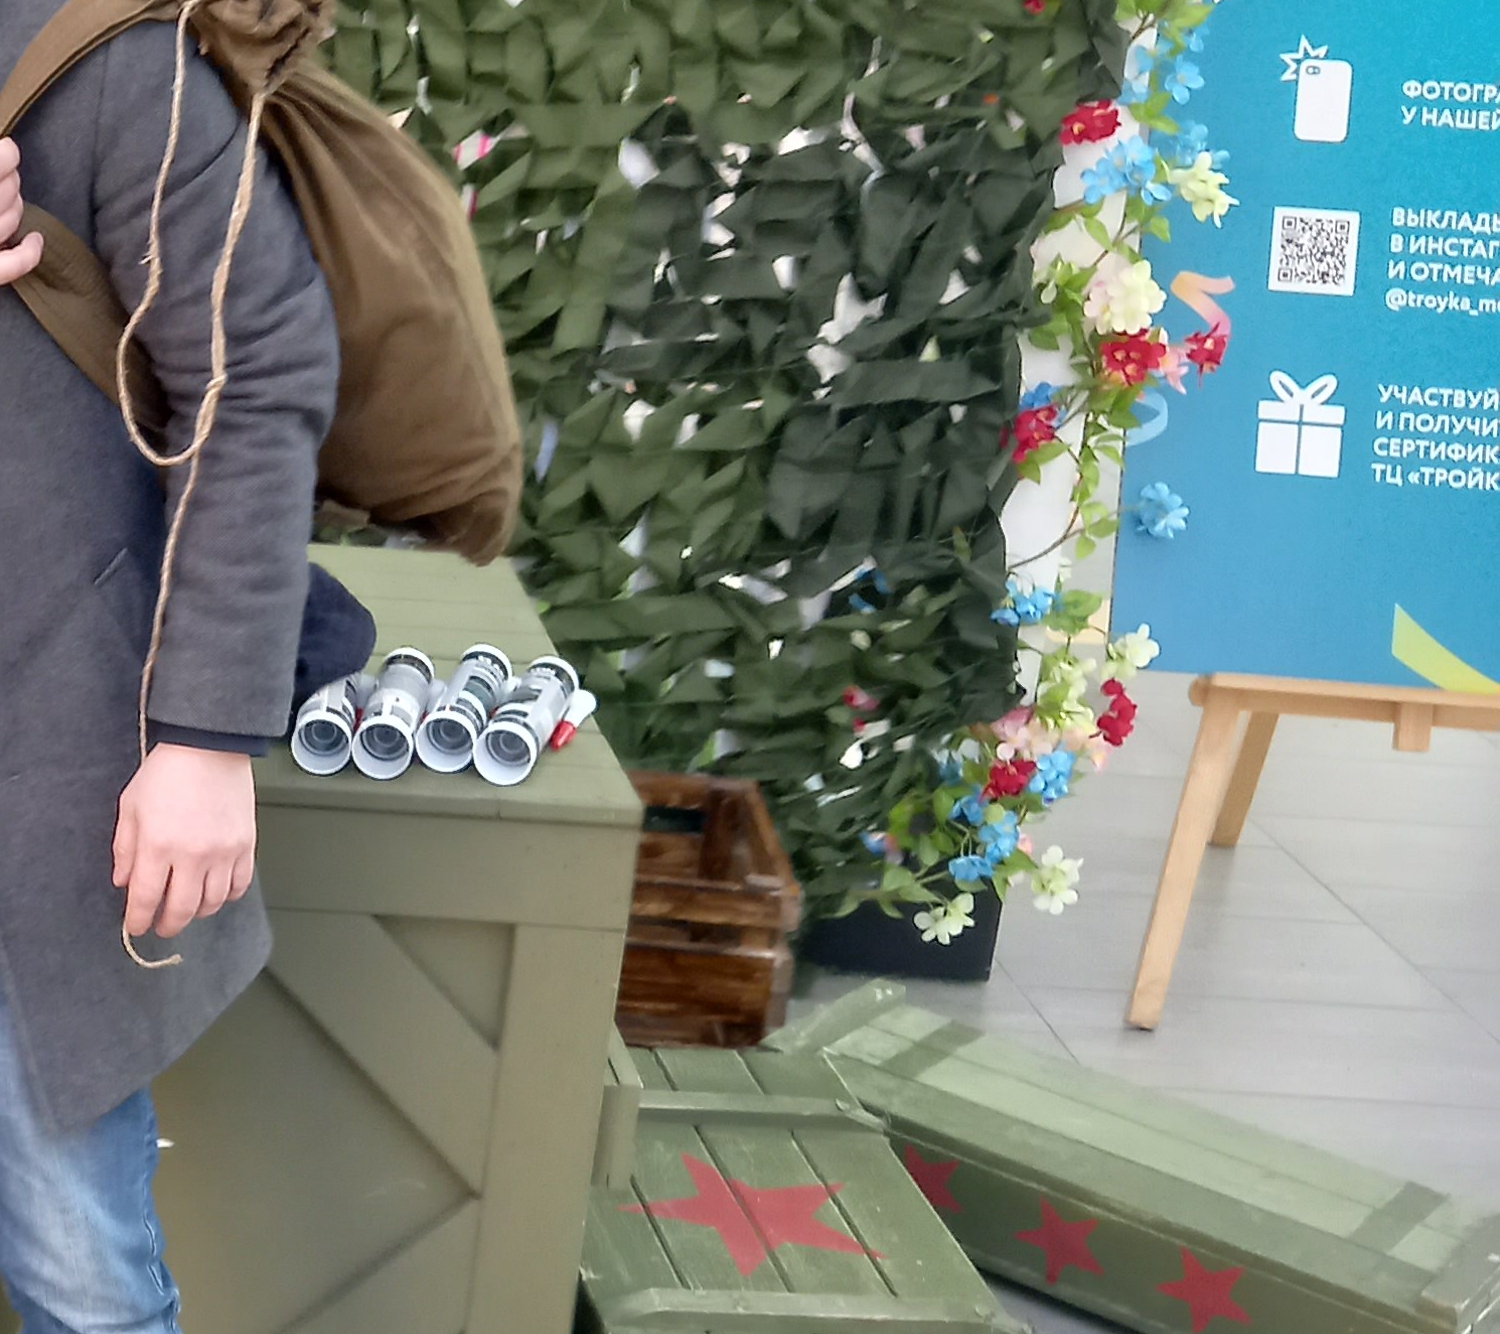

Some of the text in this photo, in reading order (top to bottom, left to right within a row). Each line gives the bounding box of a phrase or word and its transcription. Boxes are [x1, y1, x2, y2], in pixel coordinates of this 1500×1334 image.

[1402, 79, 1500, 104] ФОТОГР
[1401, 105, 1417, 125] У
[1390, 233, 1500, 259] В ИНСТАГ
[1387, 259, 1405, 280] И
[1385, 287, 1500, 316] @troyka_m
[1378, 383, 1499, 411] УЧАСТВУЙ
[1376, 410, 1500, 438] И ПОЛУЧИ
[1373, 437, 1500, 465] СЕРТИФИК
[1371, 463, 1403, 486] ТЦ
